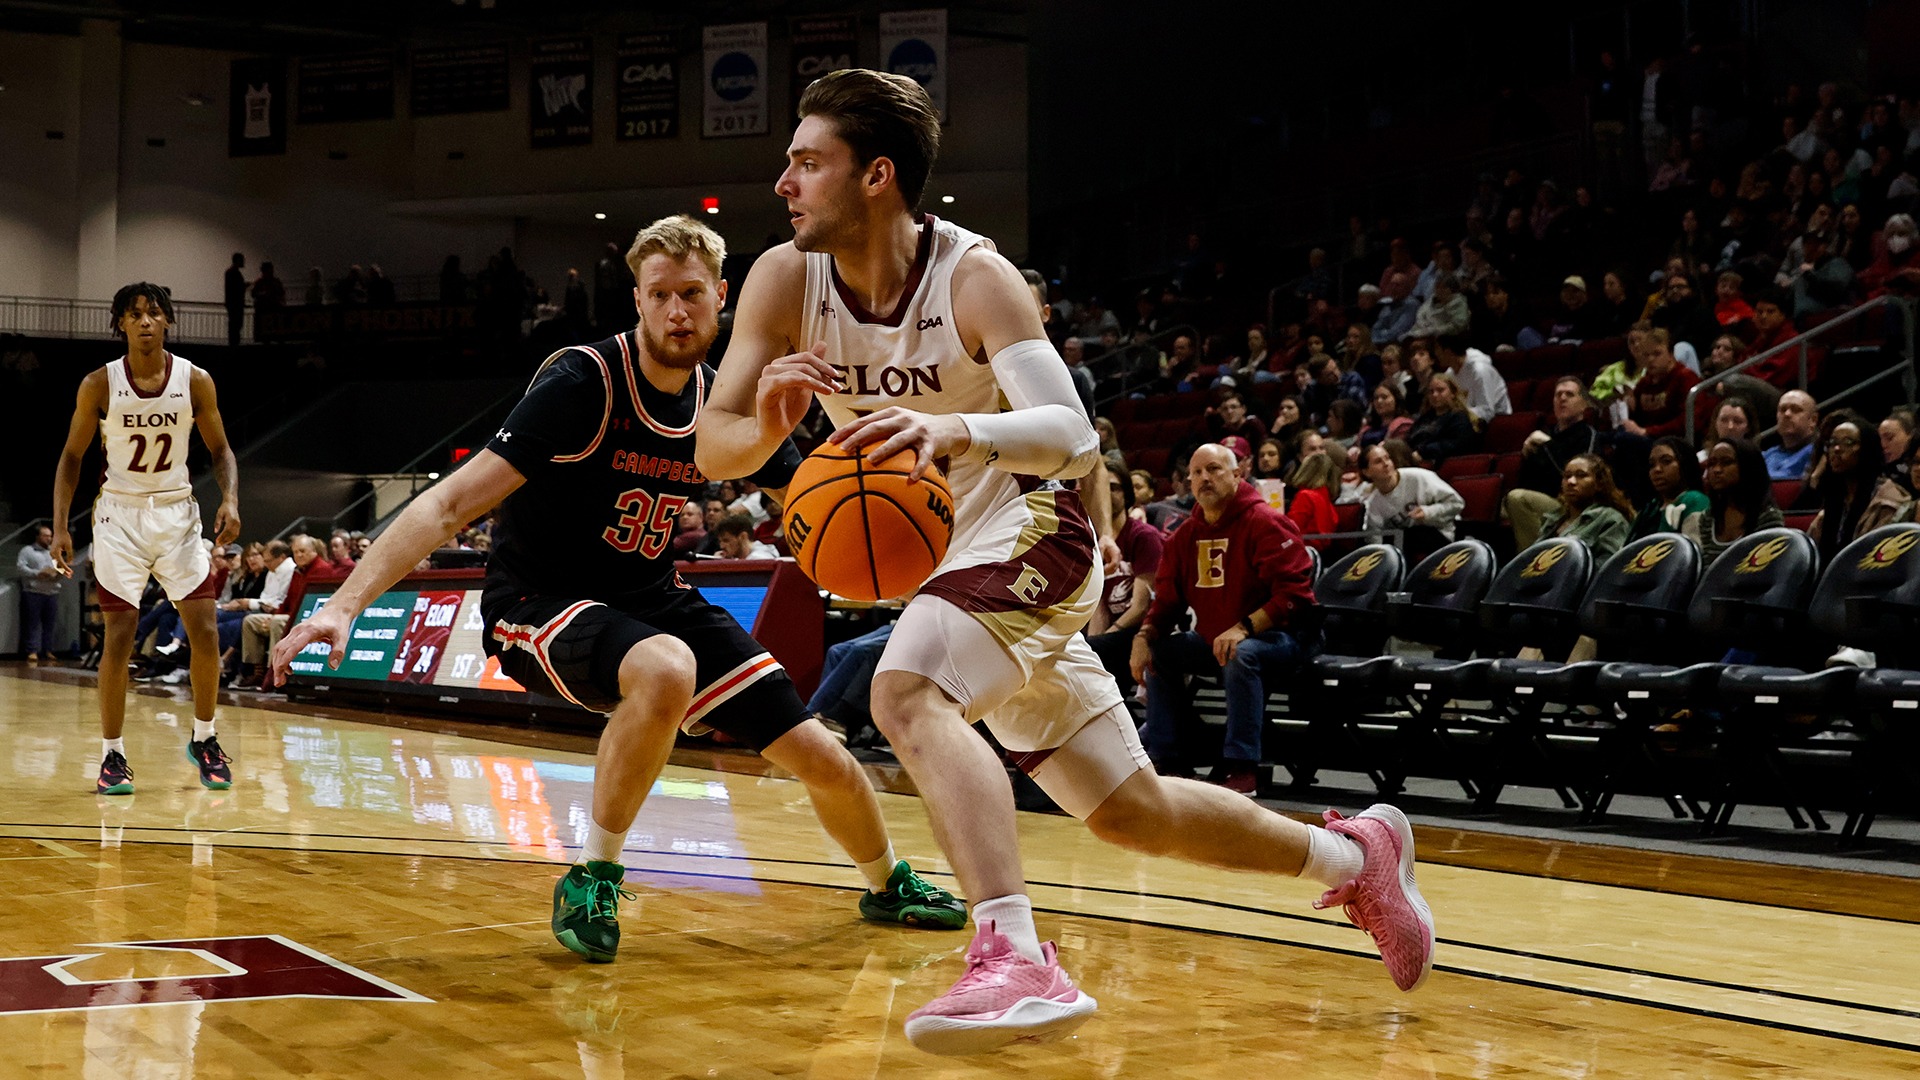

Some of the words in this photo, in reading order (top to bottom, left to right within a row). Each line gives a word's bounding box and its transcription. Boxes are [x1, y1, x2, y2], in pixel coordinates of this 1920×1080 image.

[622, 62, 674, 84] CAA
[624, 118, 671, 137] 2017
[713, 115, 758, 132] 2017
[916, 315, 943, 332] CAA
[122, 412, 179, 428] ELON
[127, 433, 173, 473] 22
[611, 449, 706, 484] CAMPBEL
[602, 487, 690, 560] 35
[1195, 537, 1230, 589] E
[1006, 561, 1049, 605] E
[424, 604, 457, 627] ELON
[412, 645, 436, 673] 24
